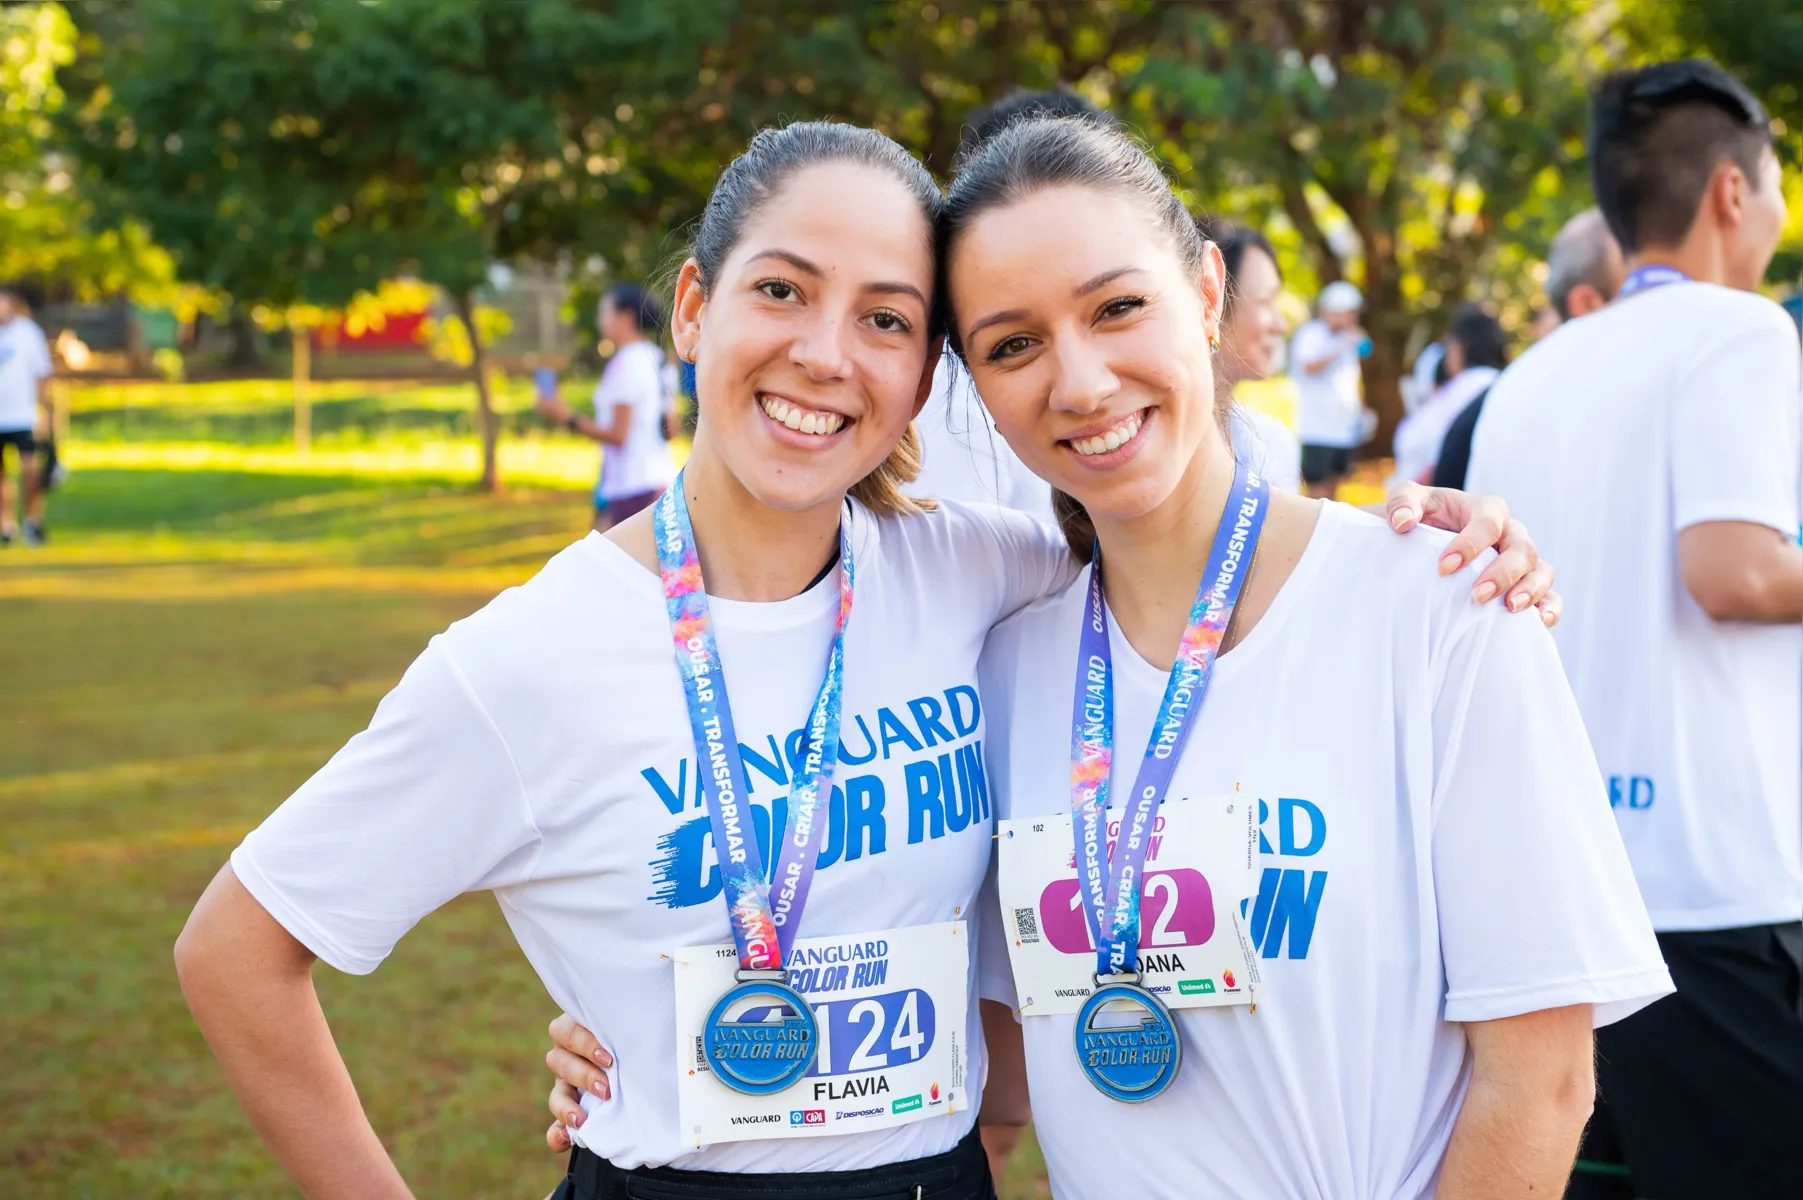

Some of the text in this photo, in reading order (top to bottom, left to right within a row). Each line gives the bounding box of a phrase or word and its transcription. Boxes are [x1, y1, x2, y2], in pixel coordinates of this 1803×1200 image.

[663, 487, 683, 554] ORMAR
[1204, 497, 1259, 622] TRANSFORMAR
[1092, 580, 1104, 633] OUSAR
[1155, 648, 1210, 760] VANGUARD
[640, 685, 981, 815] VNUARD
[687, 636, 715, 703] OUSAR
[703, 714, 747, 864] TRANSFORMAR
[904, 740, 989, 845] RUN
[1081, 655, 1107, 928] RANSFORMAR VANGUARD
[1127, 785, 1156, 850] OUSAR
[772, 861, 804, 927] OUSAR
[793, 788, 817, 848] CRIAR
[1032, 824, 1044, 833] 102
[1069, 873, 1188, 950] 12
[1115, 865, 1134, 925] CRIAR
[715, 948, 737, 958] 1124
[786, 959, 888, 994] COLOR RUN
[1054, 988, 1091, 998] VANGUARD
[714, 1043, 773, 1060] COLOR
[774, 1043, 810, 1060] RUN
[720, 1028, 811, 1042] VANGUARD
[762, 990, 925, 1075] 124
[1087, 1047, 1171, 1067] COLOR RUN
[1088, 1032, 1170, 1048] VANGUARD
[814, 1075, 890, 1101] FLAVIA
[730, 1114, 781, 1125] VANGUARD
